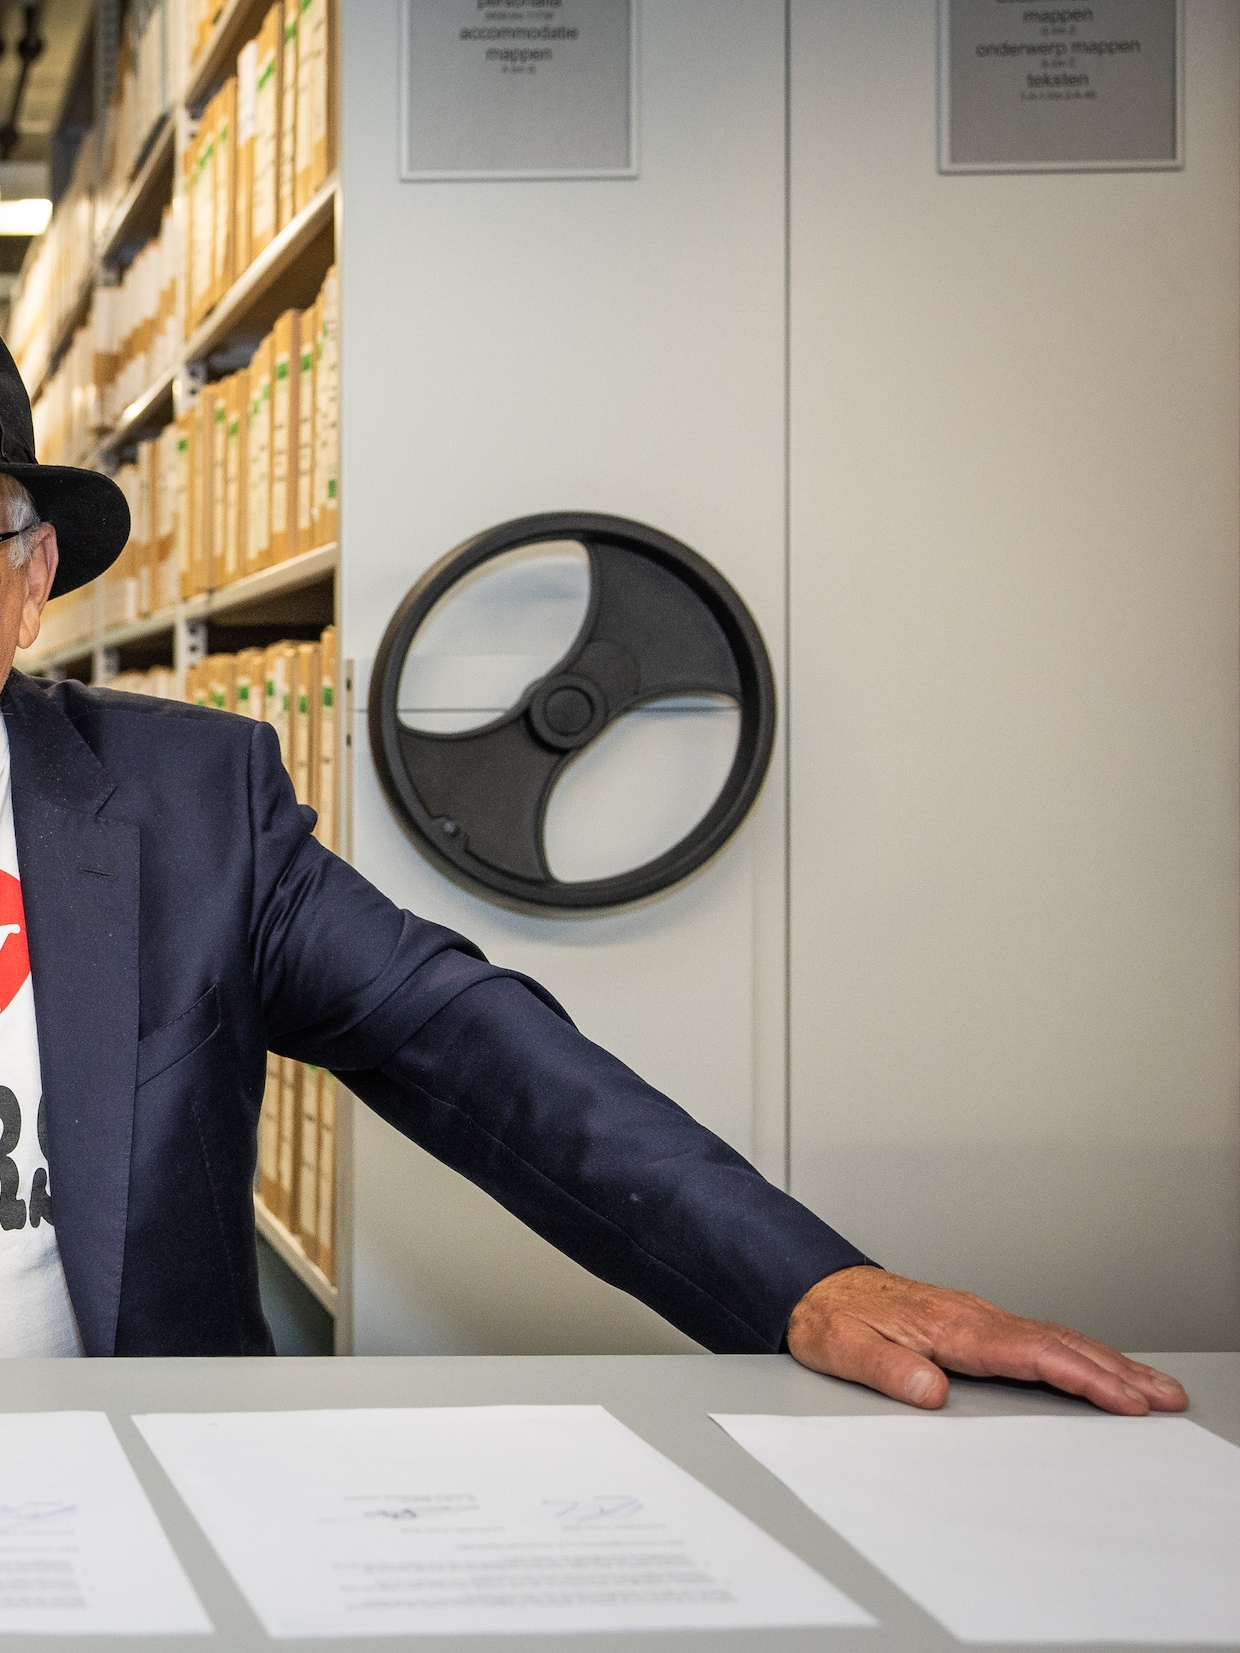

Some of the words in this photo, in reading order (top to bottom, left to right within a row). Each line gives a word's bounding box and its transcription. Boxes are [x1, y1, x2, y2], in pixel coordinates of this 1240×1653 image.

[1023, 8, 1094, 23] mappen
[461, 25, 579, 41] accommodatie
[485, 47, 553, 62] mappen
[975, 41, 1068, 57] onderwerp
[1071, 39, 1141, 55] mappen
[1026, 73, 1090, 88] teksten
